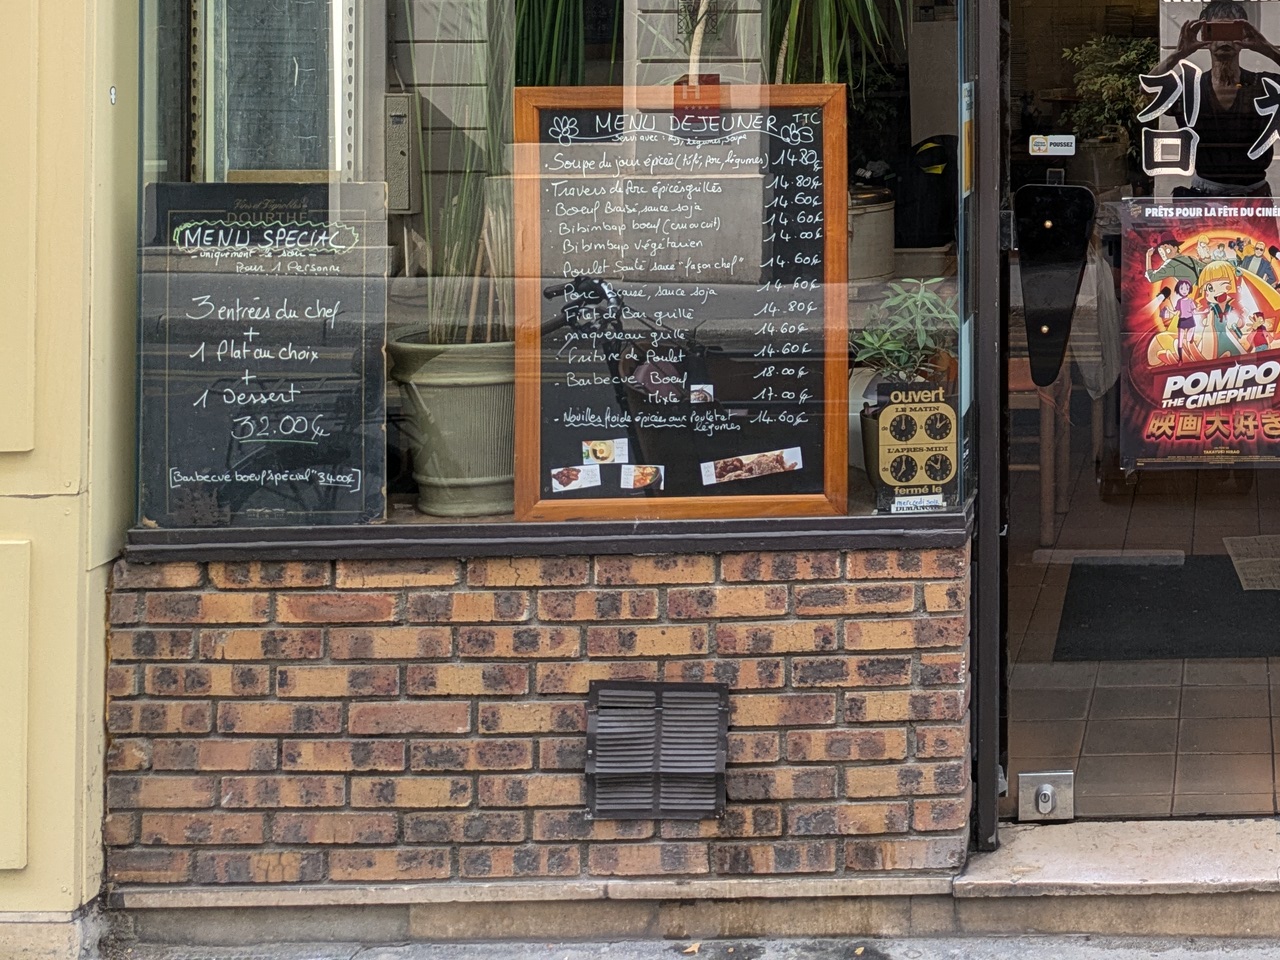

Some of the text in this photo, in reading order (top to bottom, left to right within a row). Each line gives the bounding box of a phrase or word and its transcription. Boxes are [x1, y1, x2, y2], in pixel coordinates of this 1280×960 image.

[595, 112, 821, 133] MENU DEJEUNER TTC
[548, 151, 596, 178] Soupe
[598, 151, 613, 169] du
[612, 155, 641, 178] jour
[551, 180, 607, 198] Travers
[226, 212, 309, 224] DOURTHE
[671, 202, 702, 219] soja
[1145, 205, 1175, 218] PRÊTS
[1175, 206, 1203, 218] POUR
[1204, 207, 1216, 218] LA
[1218, 204, 1239, 218] FÊTE
[1240, 206, 1254, 218] DU
[184, 227, 250, 249] MENU
[563, 259, 610, 278] Poulet
[563, 283, 600, 302] Porc
[690, 286, 718, 305] soja
[185, 294, 341, 330] 3 entrées du chef
[564, 330, 646, 348] maquereau
[189, 339, 319, 363] 1 Plat au choix
[625, 347, 639, 361] de
[645, 348, 686, 364] Poulet
[566, 371, 638, 387] Barbecue
[192, 383, 301, 409] 1 Dessert
[648, 390, 681, 405] Mixte
[889, 386, 945, 403] ouvert
[1161, 382, 1277, 410] THE CINEPHILE
[230, 413, 332, 441] 32.00€
[894, 485, 942, 495] fermé le
